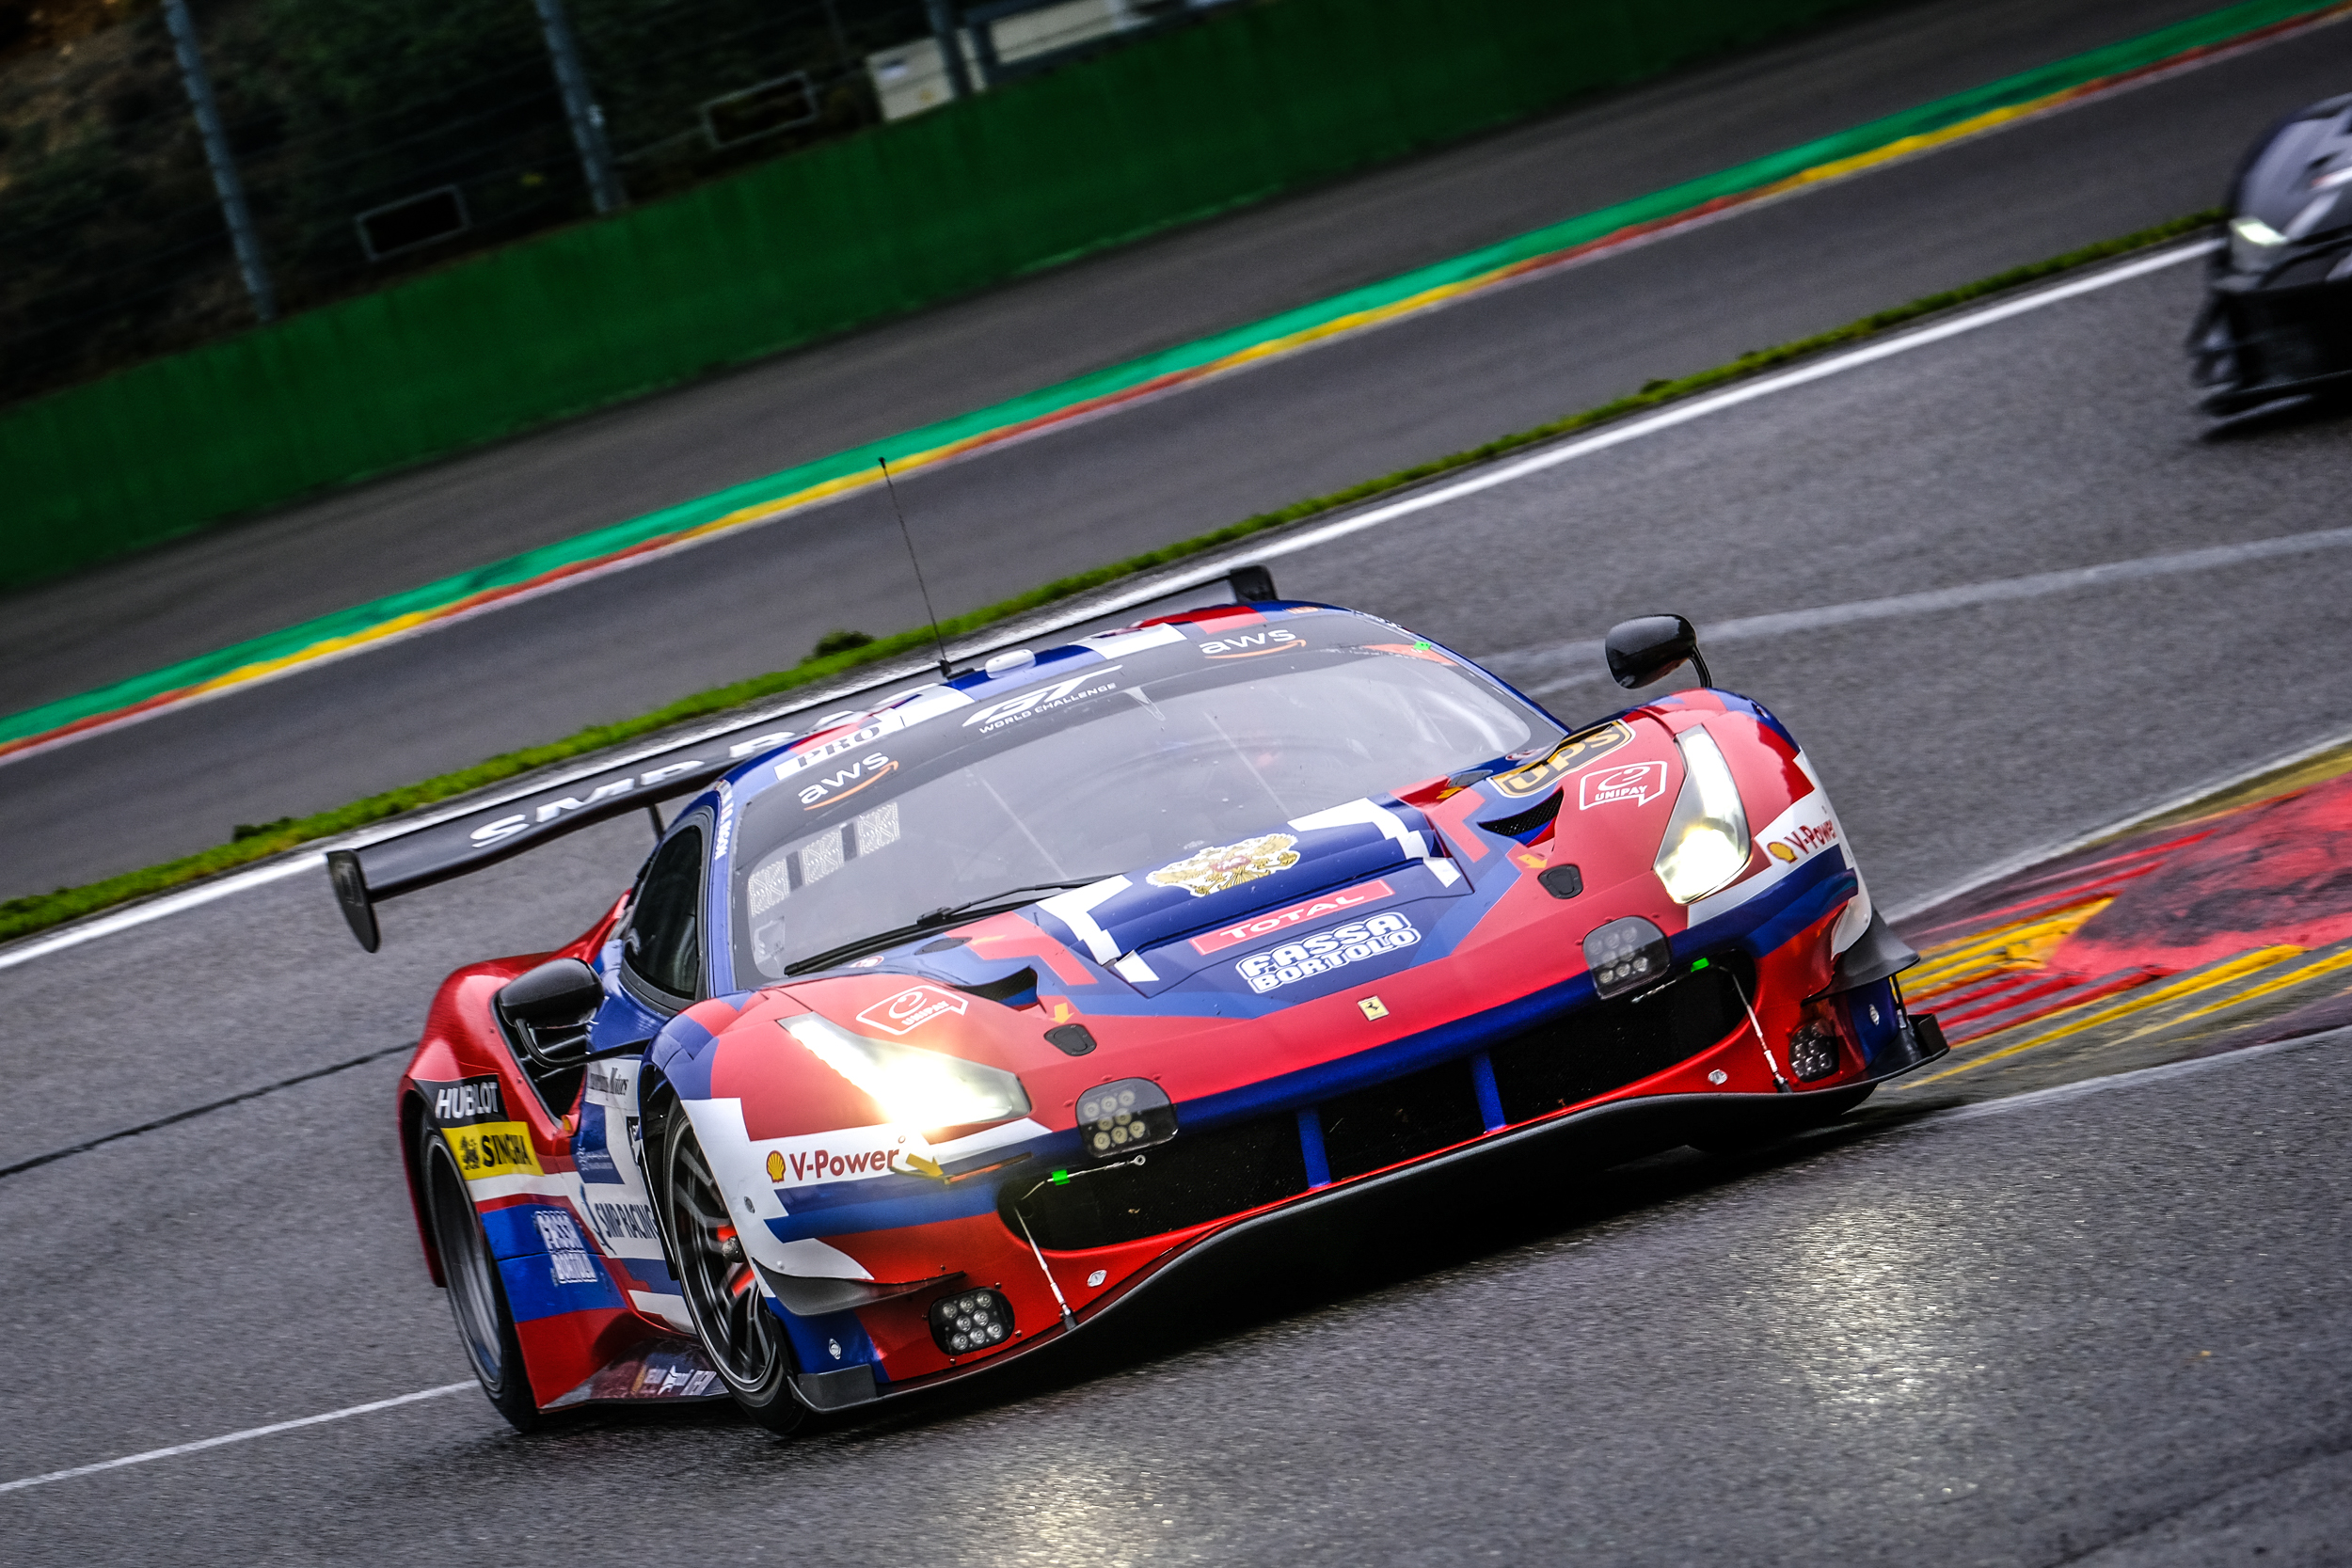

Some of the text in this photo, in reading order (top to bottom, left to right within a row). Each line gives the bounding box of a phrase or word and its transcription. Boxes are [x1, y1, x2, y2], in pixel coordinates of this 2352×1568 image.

[1199, 629, 1296, 655] aws
[979, 683, 1118, 734] WORLD CHALLENGE
[797, 726, 881, 768] PRO
[798, 752, 890, 804] aws
[1595, 784, 1648, 801] UNIPAY
[469, 760, 706, 848] SMP
[1219, 895, 1364, 939] TOTAL
[1237, 912, 1409, 979] FASSA
[1249, 928, 1420, 992] BORTOLO
[900, 1000, 950, 1026] UNIPAY
[435, 1081, 499, 1119] HUBLOT
[788, 1148, 900, 1181] V-Power
[594, 1202, 660, 1240] SMP RACING
